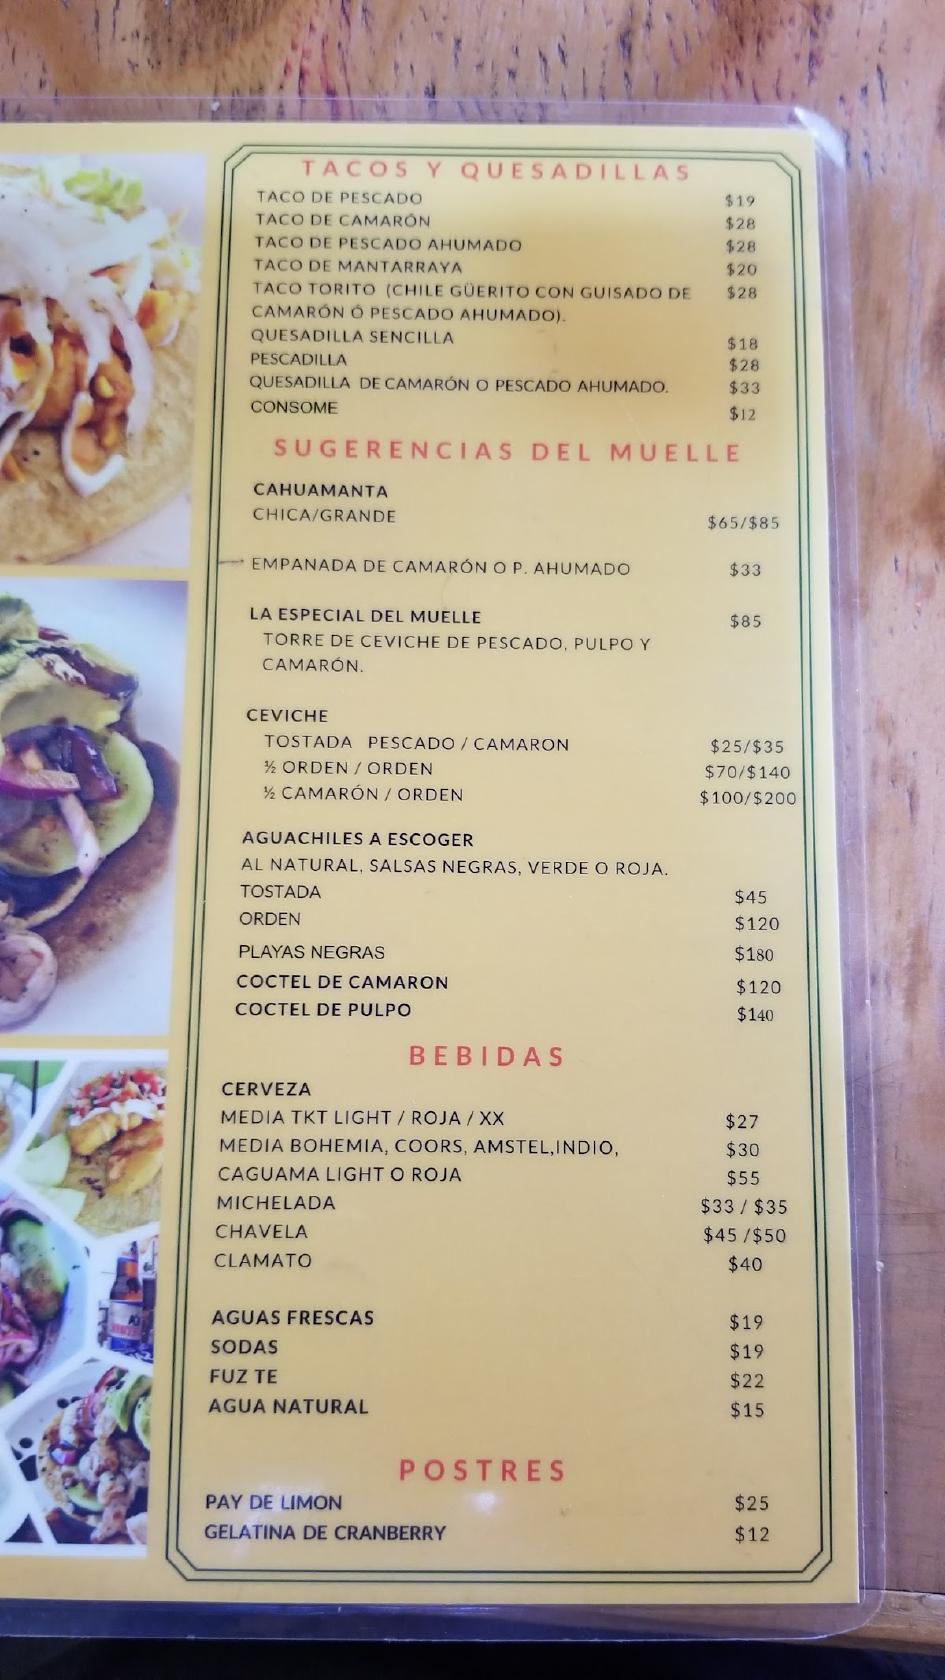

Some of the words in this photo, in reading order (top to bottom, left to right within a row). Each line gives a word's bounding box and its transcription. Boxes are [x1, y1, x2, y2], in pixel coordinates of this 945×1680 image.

[303, 160, 407, 178] TACOS
[425, 160, 441, 178] Y
[460, 161, 688, 182] QUESADILLAS
[256, 190, 305, 204] TACO
[311, 191, 333, 204] DE
[340, 191, 423, 205] PESCADO
[725, 193, 756, 208] $19
[255, 212, 304, 226] TACO
[310, 213, 332, 227] DE
[338, 212, 431, 228] CAMARÓN
[725, 215, 756, 231] $28
[254, 235, 304, 249] TACO
[309, 236, 332, 250] DE
[338, 236, 422, 251] PESCADO
[427, 238, 522, 252] AHUMADO
[725, 238, 756, 255] $28
[254, 258, 303, 272] TACO
[308, 259, 331, 273] DE
[338, 259, 463, 274] MANTARRAYA
[726, 261, 758, 278] $20
[253, 281, 302, 295] TACO
[308, 282, 376, 296] TORITO
[386, 283, 444, 299] (CHILE
[535, 285, 574, 299] CON
[579, 286, 663, 300] GUISADO
[668, 286, 690, 300] DE
[727, 284, 758, 301] $28
[251, 303, 345, 319] CAMARÓN
[370, 306, 454, 321] PESCADO
[459, 308, 566, 325] AHUMADO).
[250, 328, 364, 344] QUESADILLA
[369, 330, 454, 345] SENCILLA
[727, 335, 759, 352] $18
[250, 352, 348, 367] PESCADILLA
[729, 357, 760, 373] $28
[249, 375, 351, 390] QUESADILLA
[359, 376, 381, 390] DE
[384, 375, 470, 392] CAMARÓN
[495, 378, 572, 393] PESCADO
[576, 379, 669, 394] AHUMADO.
[729, 379, 761, 396] $33
[250, 399, 338, 415] CONSOME
[729, 405, 756, 422] $12
[274, 438, 512, 461] SUGERENCIAS
[531, 442, 591, 463] DEL
[609, 443, 739, 463] MUELLE
[253, 482, 388, 499] CAHUAMANTA
[252, 557, 357, 573] EMPANADA
[363, 559, 387, 573] DE
[392, 558, 487, 574] CAMARÓN
[533, 561, 631, 576] AHUMADO
[729, 561, 761, 578] $33
[250, 607, 273, 621] LA
[278, 607, 365, 623] ESPECIAL
[371, 609, 404, 623] DEL
[410, 610, 481, 624] MUELLE
[730, 613, 762, 630] $85
[263, 632, 325, 647] TORRE
[330, 633, 354, 648] DE
[360, 634, 440, 649] CEVICHE
[447, 635, 471, 649] DE
[477, 636, 567, 652] PESCADO,
[574, 637, 634, 651] PULPO
[639, 638, 651, 651] Y
[262, 656, 364, 673] CAMARÓN.
[246, 708, 328, 723] CEVICHE
[264, 734, 353, 749] TOSTADA
[368, 735, 455, 751] PESCADO
[473, 737, 569, 752] CAMARON
[282, 760, 348, 775] ORDEN
[367, 761, 433, 776] ORDEN
[281, 784, 378, 801] CAMARÓN
[397, 787, 463, 802] ORDEN
[242, 831, 363, 846] AGUACHILES
[368, 832, 382, 846] A
[388, 832, 474, 847] ESCOGER
[241, 857, 264, 871] AL
[270, 857, 363, 874] NATURAL,
[369, 858, 436, 874] SALSAS
[442, 859, 522, 877] NEGRAS,
[527, 861, 589, 875] VERDE
[594, 861, 609, 875] O
[616, 861, 668, 876] ROJA.
[239, 884, 322, 899] TOSTADA
[734, 888, 767, 906] $45
[239, 911, 301, 926] ORDEN
[735, 916, 780, 933] $120
[239, 944, 305, 959] PLAYAS
[311, 945, 385, 960] NEGRAS
[735, 946, 774, 963] $180
[236, 974, 312, 989] COCTEL
[318, 974, 343, 989] DE
[348, 975, 448, 990] CAMARON
[736, 978, 782, 996] $120
[235, 1002, 311, 1017] COCTEL
[316, 1002, 342, 1017] DE
[348, 1002, 411, 1018] PULPO
[737, 1005, 774, 1023] $140
[409, 1045, 563, 1067] BEBIDAS
[221, 1081, 311, 1097] CERVEZA
[221, 1109, 285, 1125] MEDIA
[290, 1109, 328, 1125] TKT
[334, 1110, 392, 1125] LIGHT
[411, 1110, 461, 1126] ROJA
[479, 1110, 505, 1126] XX
[725, 1112, 759, 1131] $27
[219, 1138, 284, 1153] MEDIA
[290, 1138, 389, 1156] BOHEMIA,
[394, 1138, 468, 1156] COORS,
[726, 1140, 760, 1159] $30
[218, 1166, 320, 1182] CAGUAMA
[326, 1166, 385, 1182] LIGHT
[390, 1166, 405, 1182] O
[412, 1166, 462, 1182] ROJA
[727, 1169, 760, 1187] $55
[217, 1195, 336, 1211] MICHELADA
[701, 1196, 734, 1215] $33
[754, 1197, 788, 1216] $35
[215, 1223, 309, 1239] CHAVELA
[703, 1225, 737, 1245] $45
[214, 1253, 312, 1268] CLAMATO
[728, 1255, 763, 1274] $40
[211, 1309, 281, 1326] AGUAS
[287, 1309, 374, 1326] FRESCAS
[729, 1313, 763, 1332] $19
[210, 1339, 278, 1355] SODAS
[730, 1342, 764, 1361] $19
[209, 1368, 248, 1384] FUZ
[254, 1369, 278, 1385] TE
[730, 1370, 765, 1390] $22
[208, 1398, 266, 1414] AGUA
[273, 1398, 369, 1415] NATURAL
[730, 1400, 765, 1420] $15
[399, 1458, 565, 1483] POSTRES
[205, 1493, 244, 1510] PAY
[249, 1494, 274, 1510] DE
[281, 1494, 343, 1511] LIMON
[735, 1493, 769, 1513] $25
[204, 1523, 296, 1541] GELATINA
[303, 1524, 328, 1541] DE
[334, 1524, 447, 1541] CRANBERRY
[735, 1524, 770, 1545] $12
